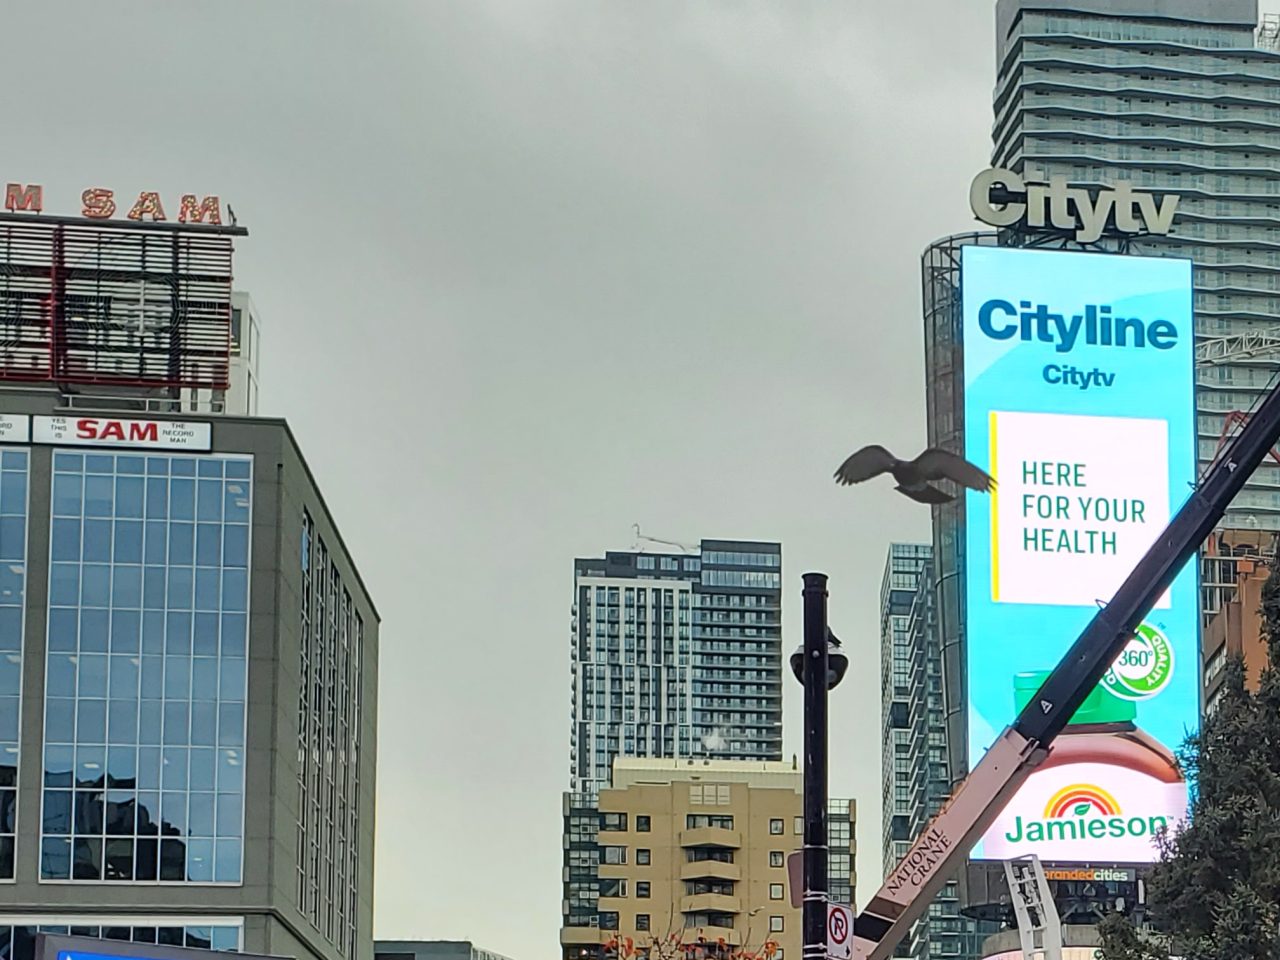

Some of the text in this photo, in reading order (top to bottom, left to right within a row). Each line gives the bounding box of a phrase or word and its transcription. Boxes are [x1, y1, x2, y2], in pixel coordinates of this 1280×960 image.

[81, 188, 221, 225] SAM
[969, 168, 1180, 244] Citytv
[978, 299, 1178, 353] Cityline
[1042, 364, 1115, 390] Citytv
[76, 419, 158, 442] SAM
[1022, 461, 1087, 487] HERE
[1022, 494, 1145, 523] FOR YOUR
[1023, 527, 1117, 555] HEALTH
[1145, 634, 1169, 687] QUALITY
[1005, 814, 1167, 843] Jamieson
[887, 828, 943, 896] NATIONAL
[911, 835, 952, 886] CRANE
